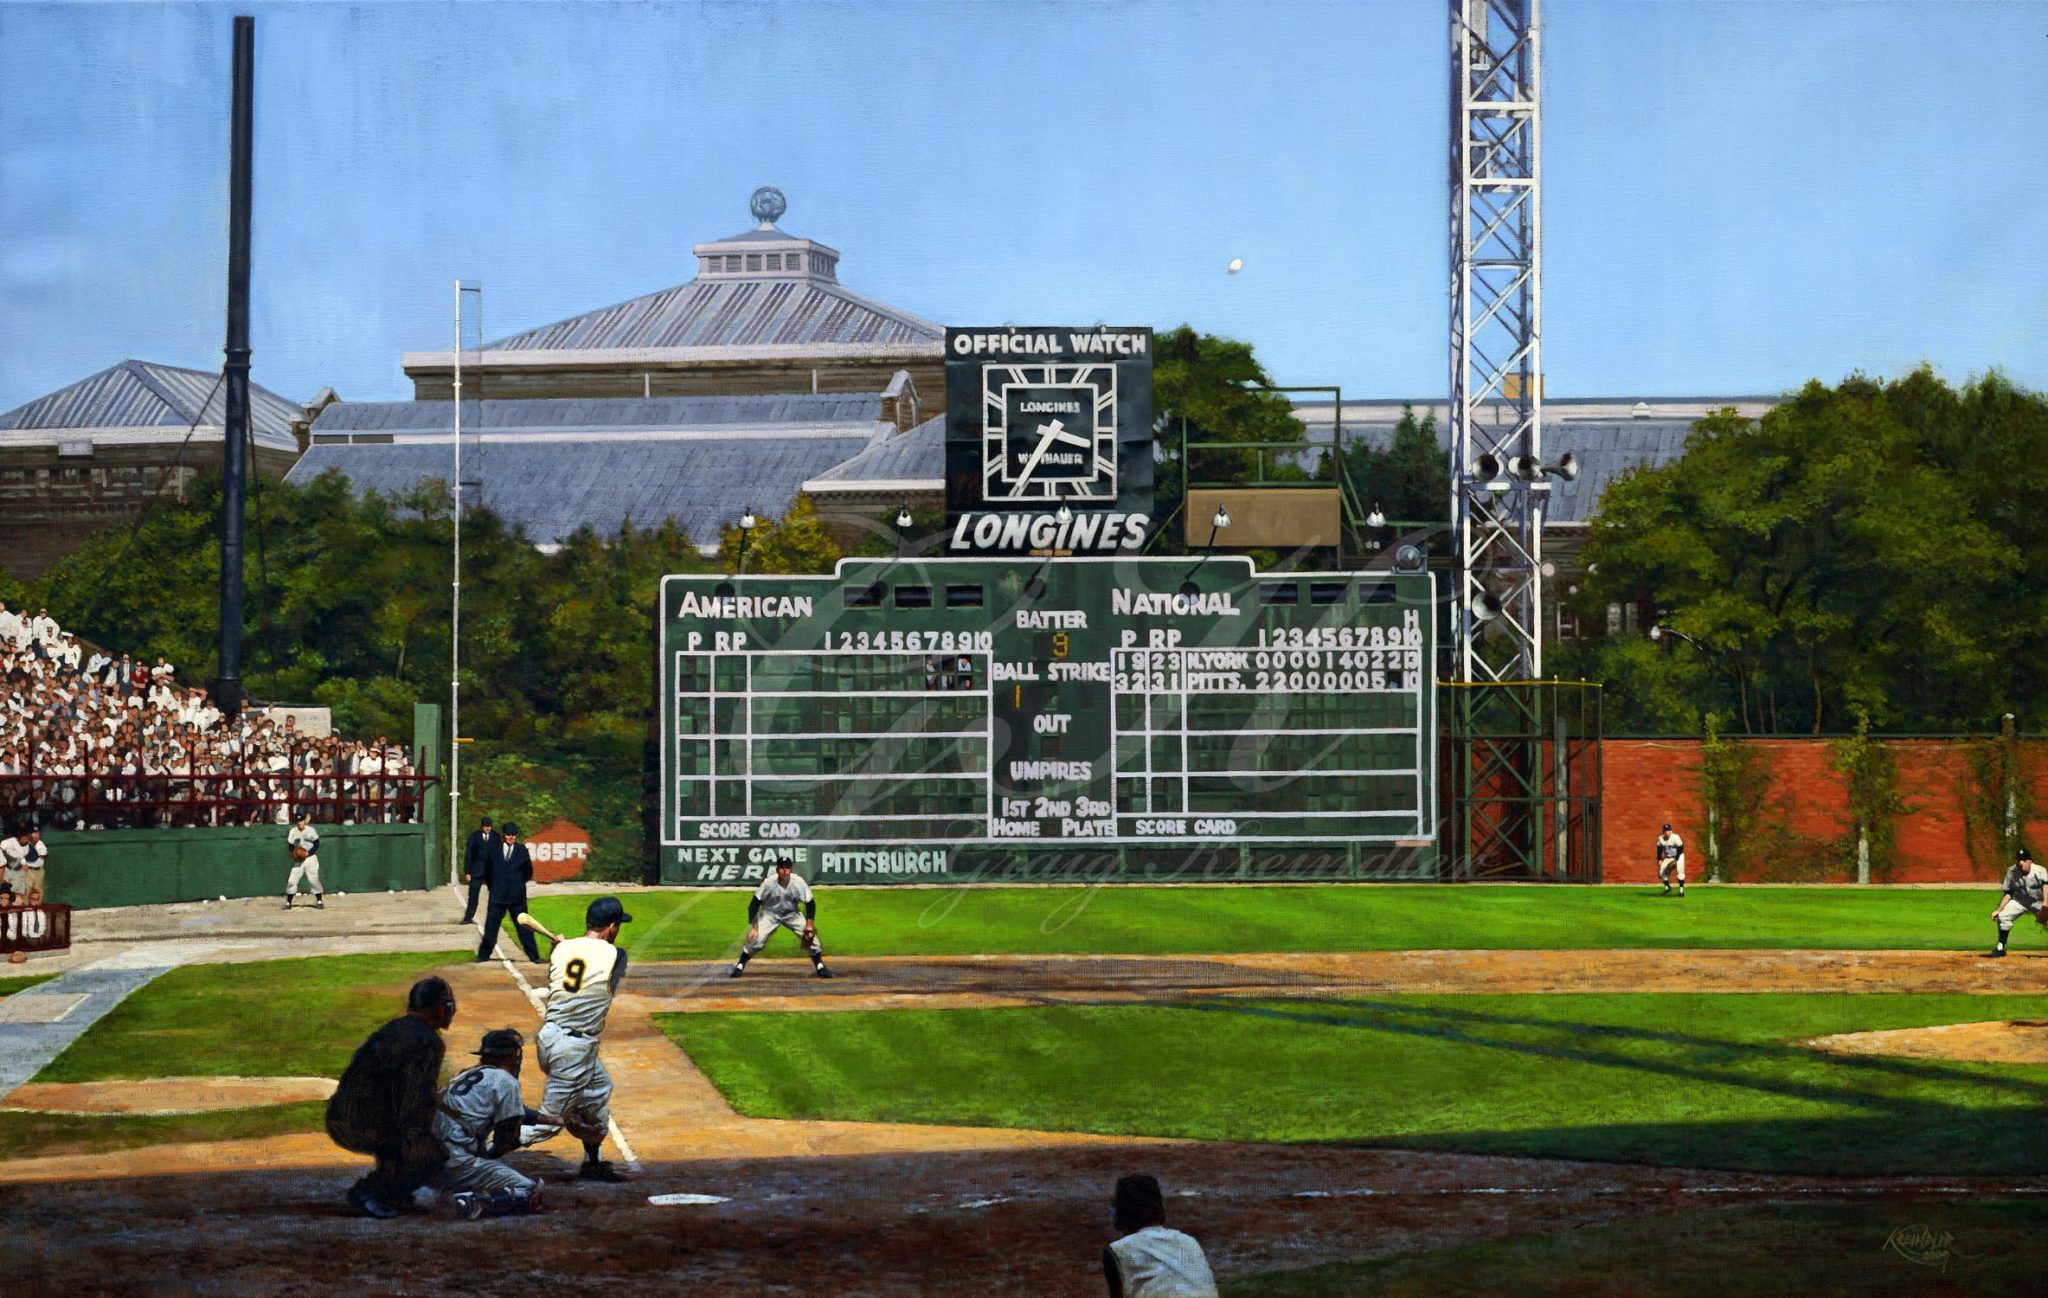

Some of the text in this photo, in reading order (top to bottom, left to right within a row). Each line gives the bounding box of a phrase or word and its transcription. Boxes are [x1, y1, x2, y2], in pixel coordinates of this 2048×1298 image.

[954, 334, 1147, 356] OFFICIAL WATCH
[1019, 401, 1080, 413] LONGINES
[950, 513, 1150, 550] LONGINES
[678, 591, 813, 619] AMERICAN
[1112, 588, 1240, 616] NATIONAL
[1016, 610, 1088, 629] BATTER
[687, 631, 703, 651] P
[1121, 629, 1137, 648] P
[1187, 652, 1250, 670] N.YORK
[992, 662, 1112, 682] BALL STRIKE
[1187, 672, 1247, 691] PITTS.
[1033, 714, 1071, 734] OUT
[1010, 761, 1093, 781] UMPIRES
[699, 822, 801, 839] SCORE CARD
[993, 818, 1117, 837] HOME PLATE
[1135, 819, 1238, 836] SCORE CARD
[678, 847, 807, 863] NEXT GAME
[822, 850, 948, 874] PITTSBURGH
[562, 957, 586, 993] 9
[449, 1071, 485, 1097] 8
